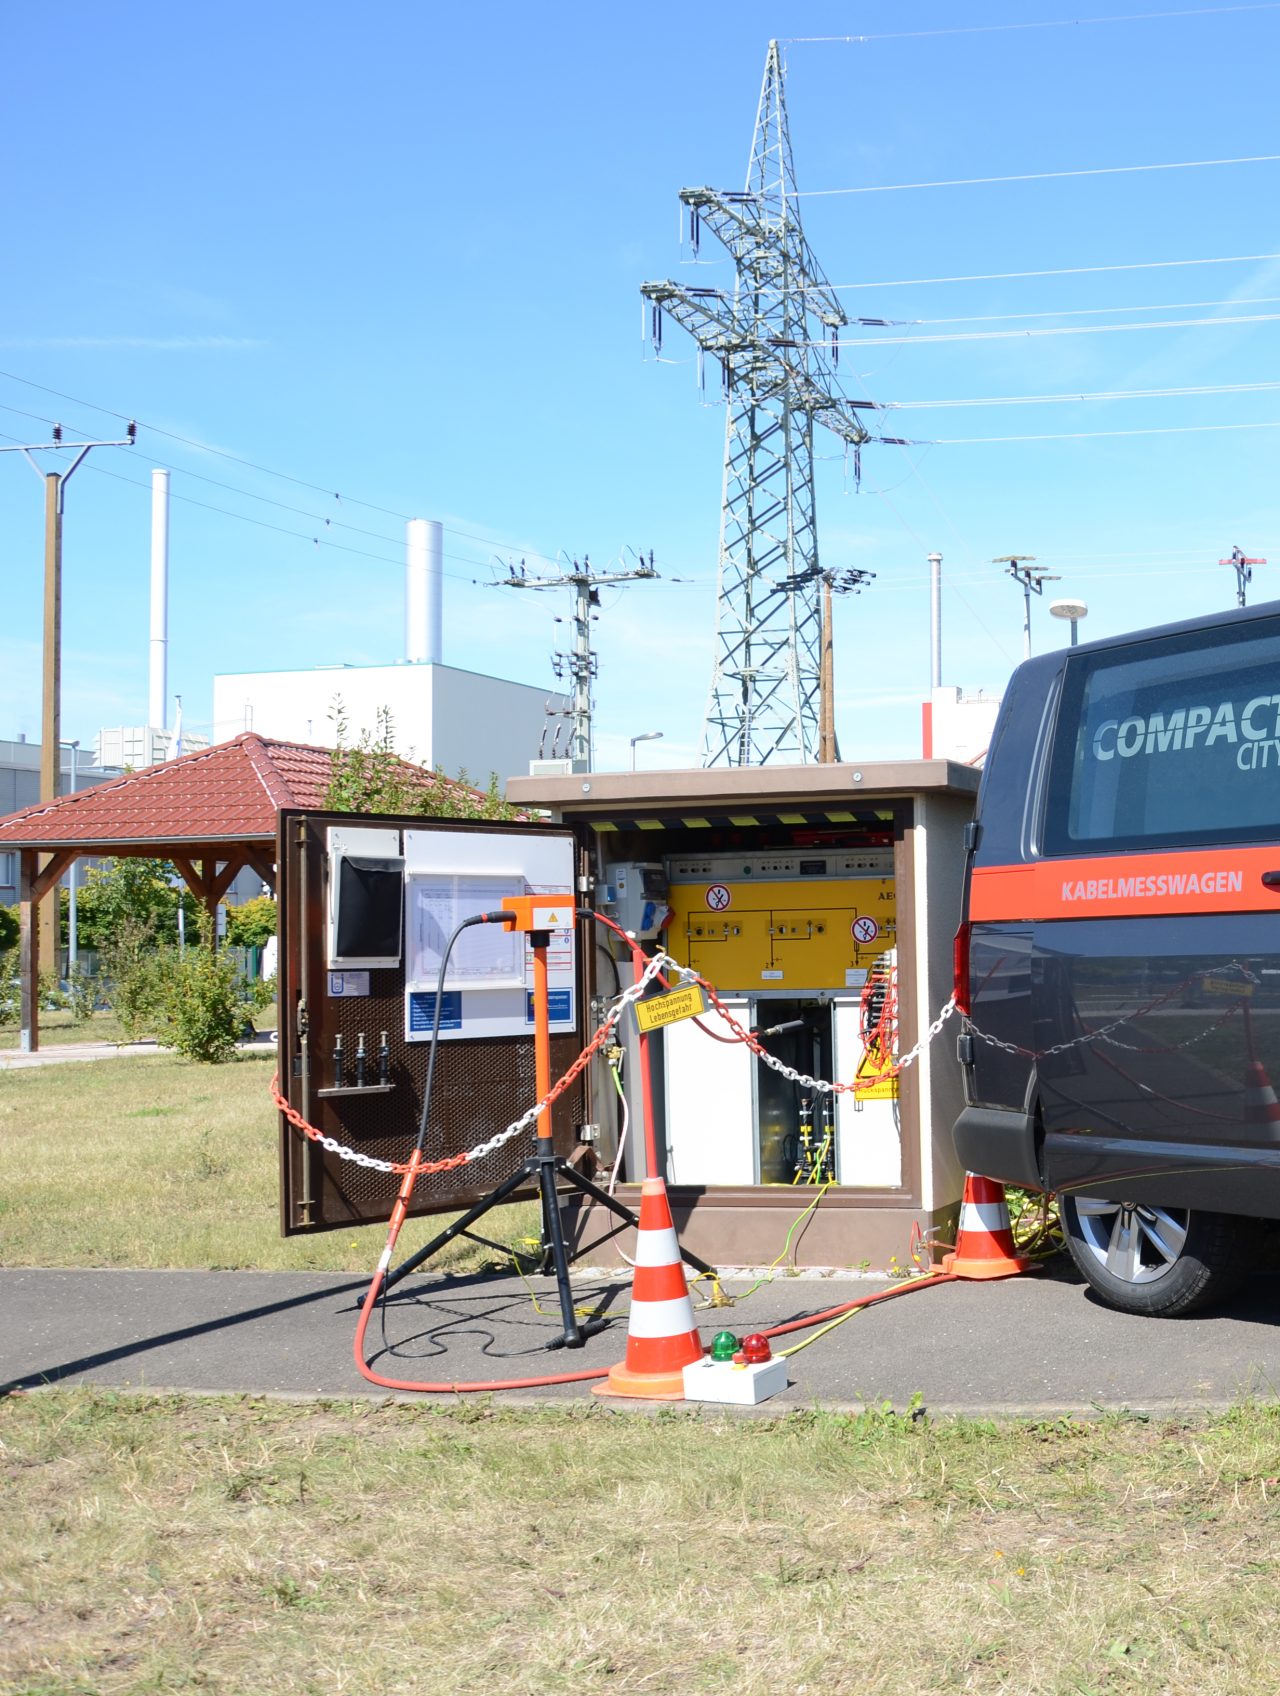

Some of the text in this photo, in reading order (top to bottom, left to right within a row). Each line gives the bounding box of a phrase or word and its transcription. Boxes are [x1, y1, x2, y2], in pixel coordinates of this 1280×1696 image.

[878, 891, 896, 900] AE
[1061, 871, 1244, 902] KABELMESSWAGEN
[645, 993, 693, 1013] Hochspannung
[649, 1003, 692, 1024] Lebensgefahr
